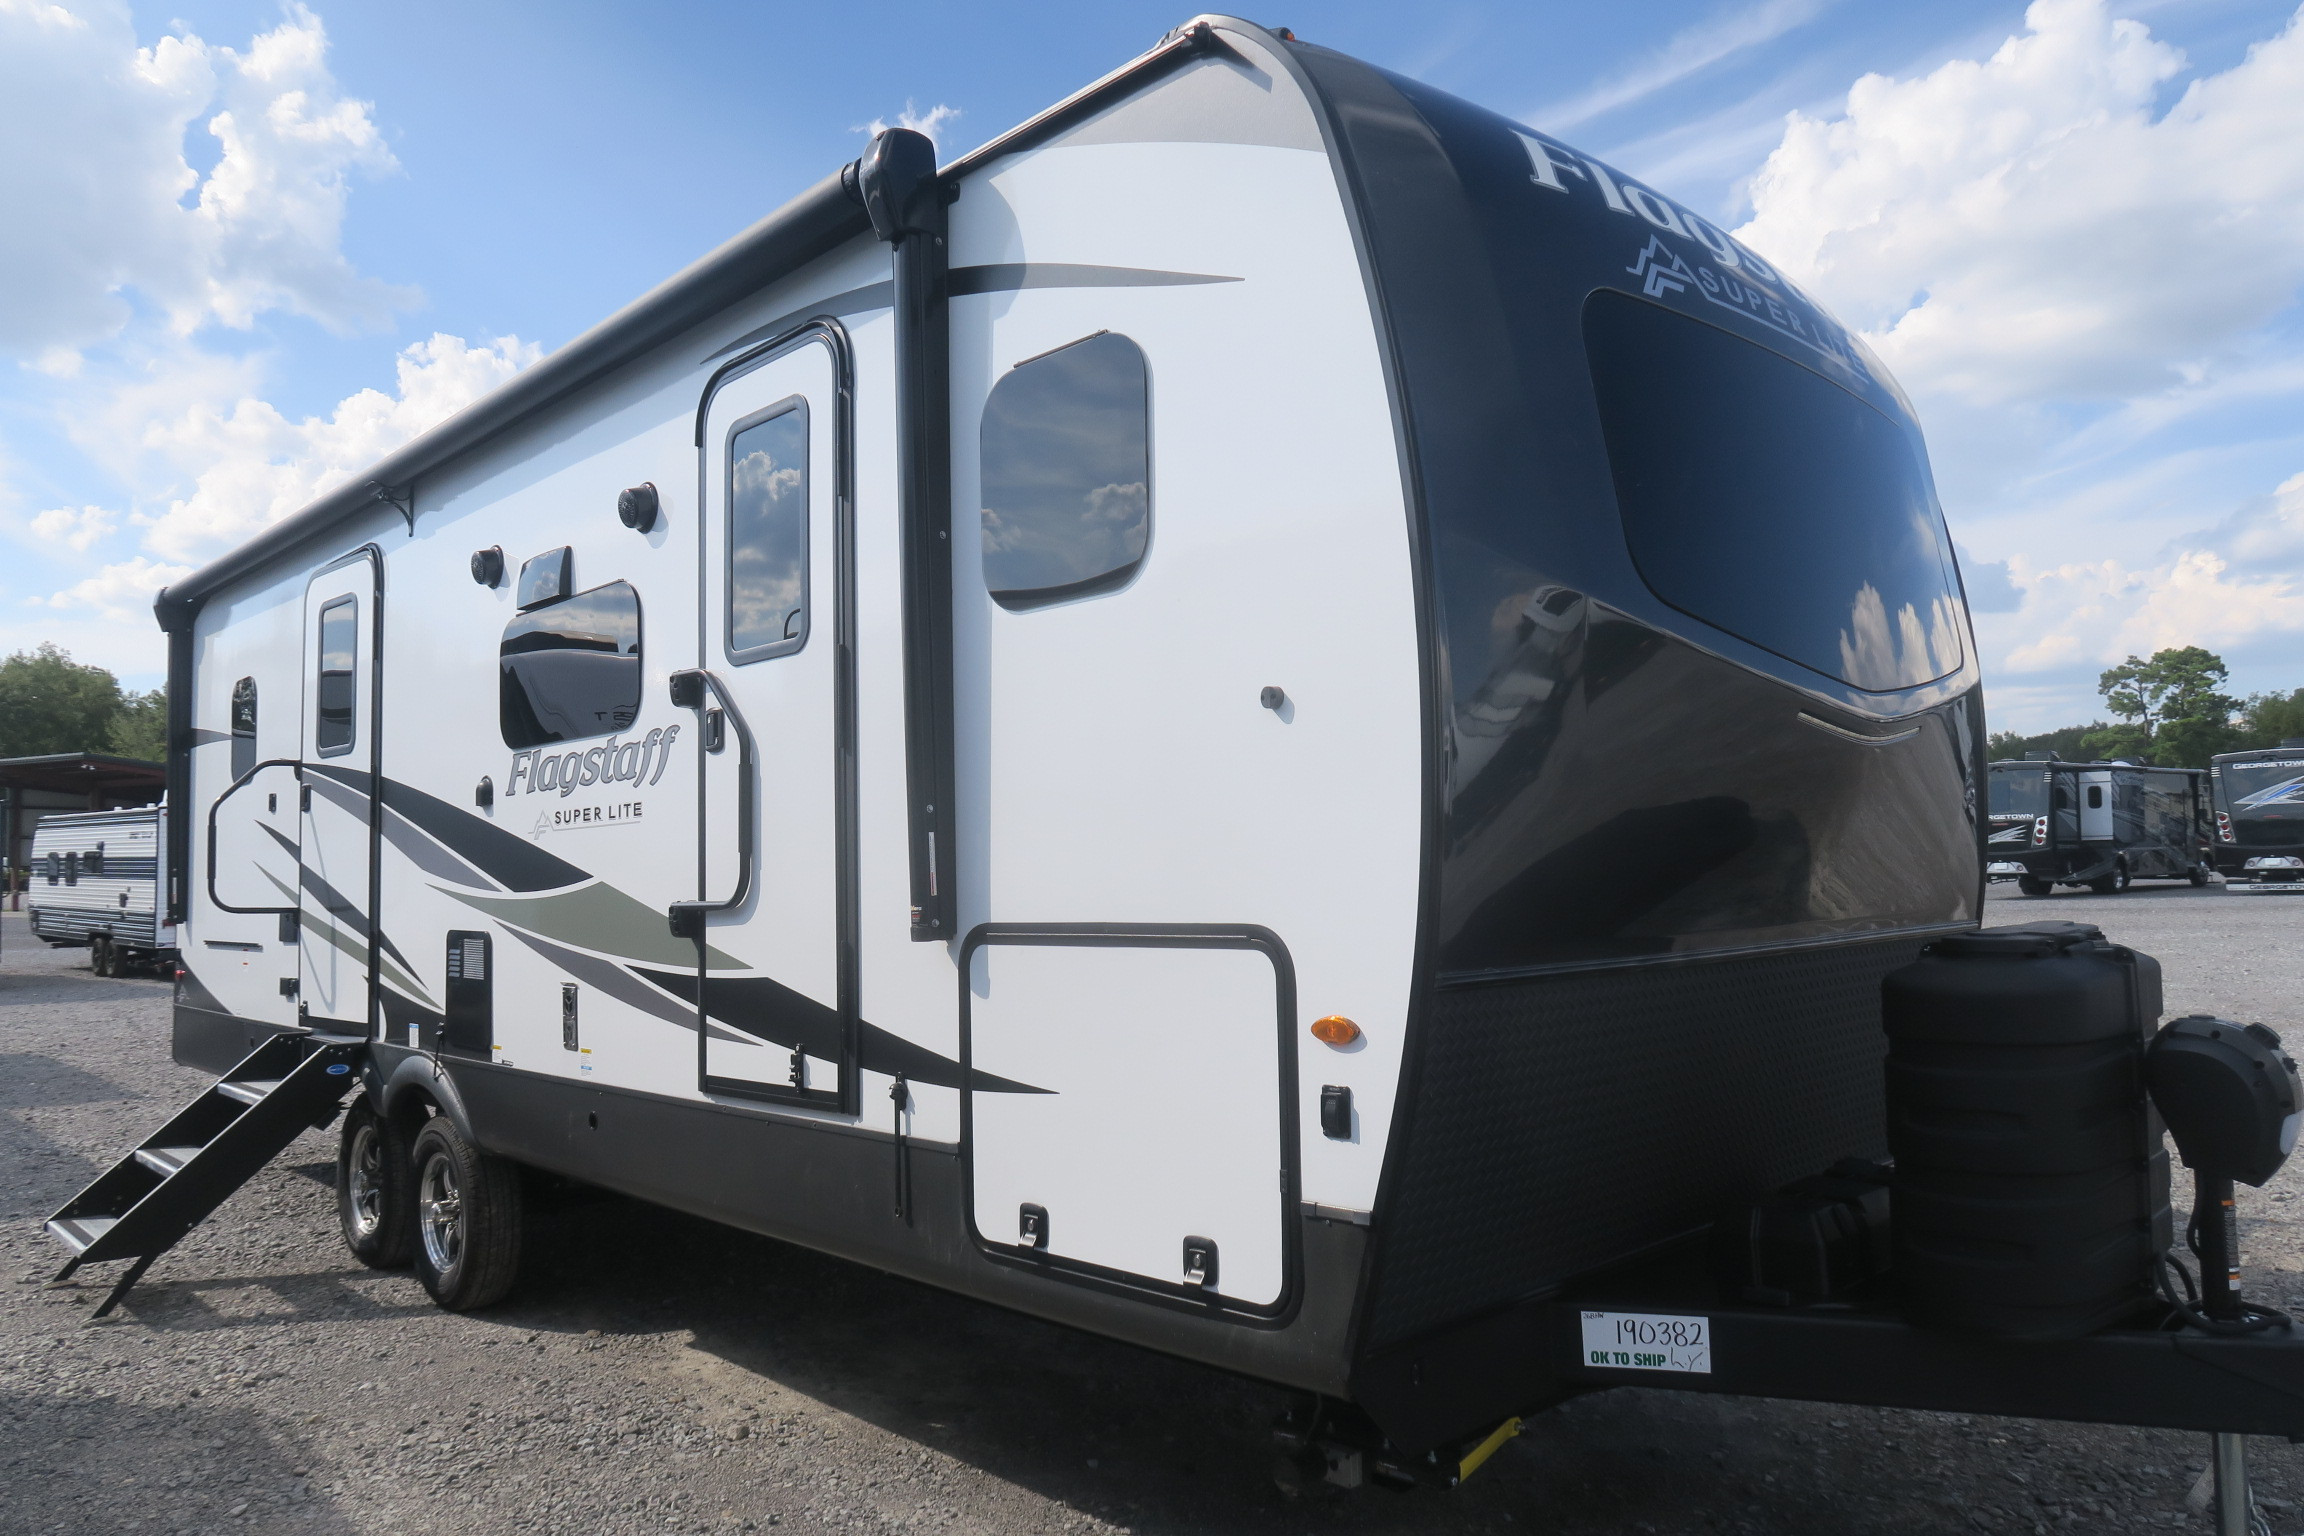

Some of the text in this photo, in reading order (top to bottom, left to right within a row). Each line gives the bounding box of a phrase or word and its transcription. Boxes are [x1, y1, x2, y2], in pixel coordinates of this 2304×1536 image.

[1698, 266, 1866, 375] SUPER LITE
[505, 724, 681, 798] Flagstaff
[554, 802, 643, 825] SUPER LITE
[1616, 1319, 1704, 1347] 190382
[1590, 1350, 1667, 1367] OK TO SHIP
